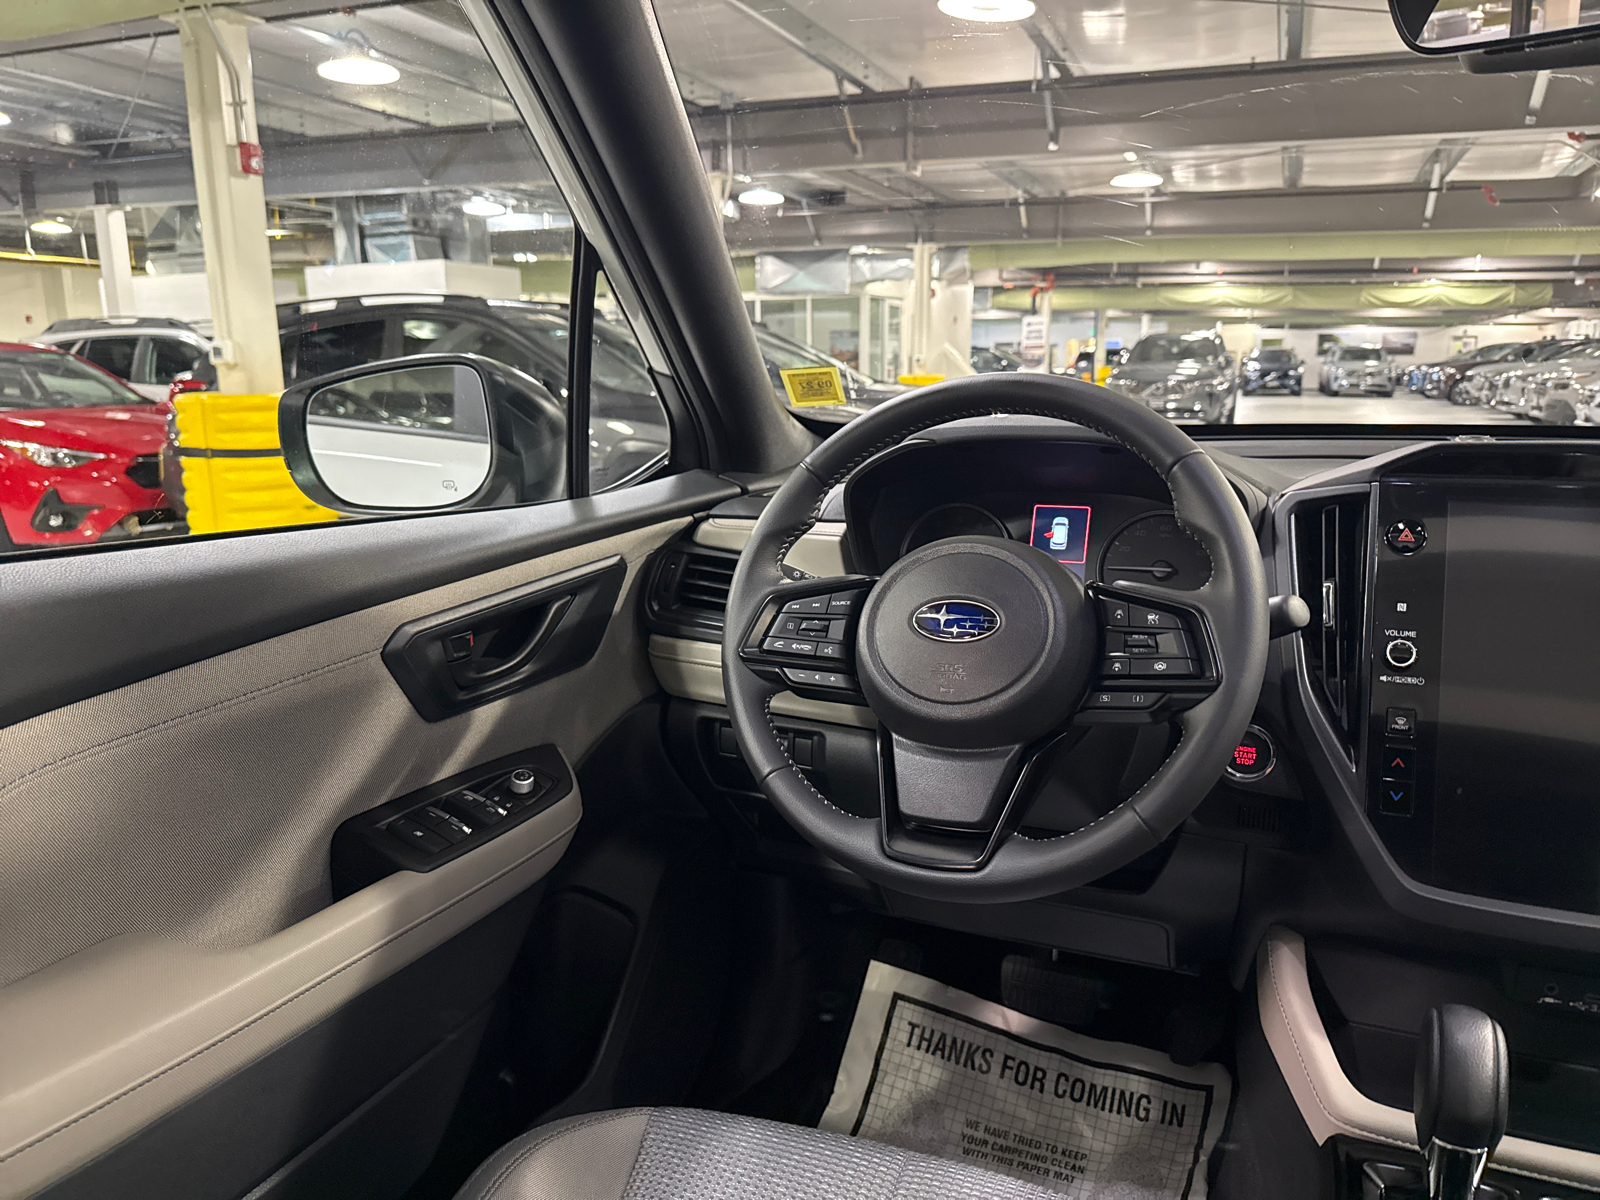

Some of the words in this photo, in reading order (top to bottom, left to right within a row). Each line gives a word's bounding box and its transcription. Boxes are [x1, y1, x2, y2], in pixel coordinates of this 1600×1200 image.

[1384, 629, 1417, 638] VOLUME
[936, 663, 963, 672] SRS
[1234, 751, 1257, 760] START
[1236, 757, 1254, 765] STOP
[907, 1021, 994, 1075] THANKS
[1000, 1054, 1047, 1094] FOR
[1054, 1072, 1151, 1123] COMING
[1160, 1100, 1186, 1128] IN
[966, 1118, 981, 1132] WE
[983, 1124, 1010, 1140] HAVE
[1012, 1133, 1041, 1150] TRIED
[1045, 1143, 1058, 1154] TO
[1061, 1148, 1088, 1161] KEEP
[961, 1132, 989, 1149] YOUR
[991, 1141, 1048, 1164] CARPETING
[1051, 1157, 1085, 1174] CLEAN
[962, 1146, 989, 1160] WITH
[991, 1154, 1014, 1167] THIS
[1016, 1160, 1050, 1177] PAPER
[1053, 1171, 1076, 1184] MAT
